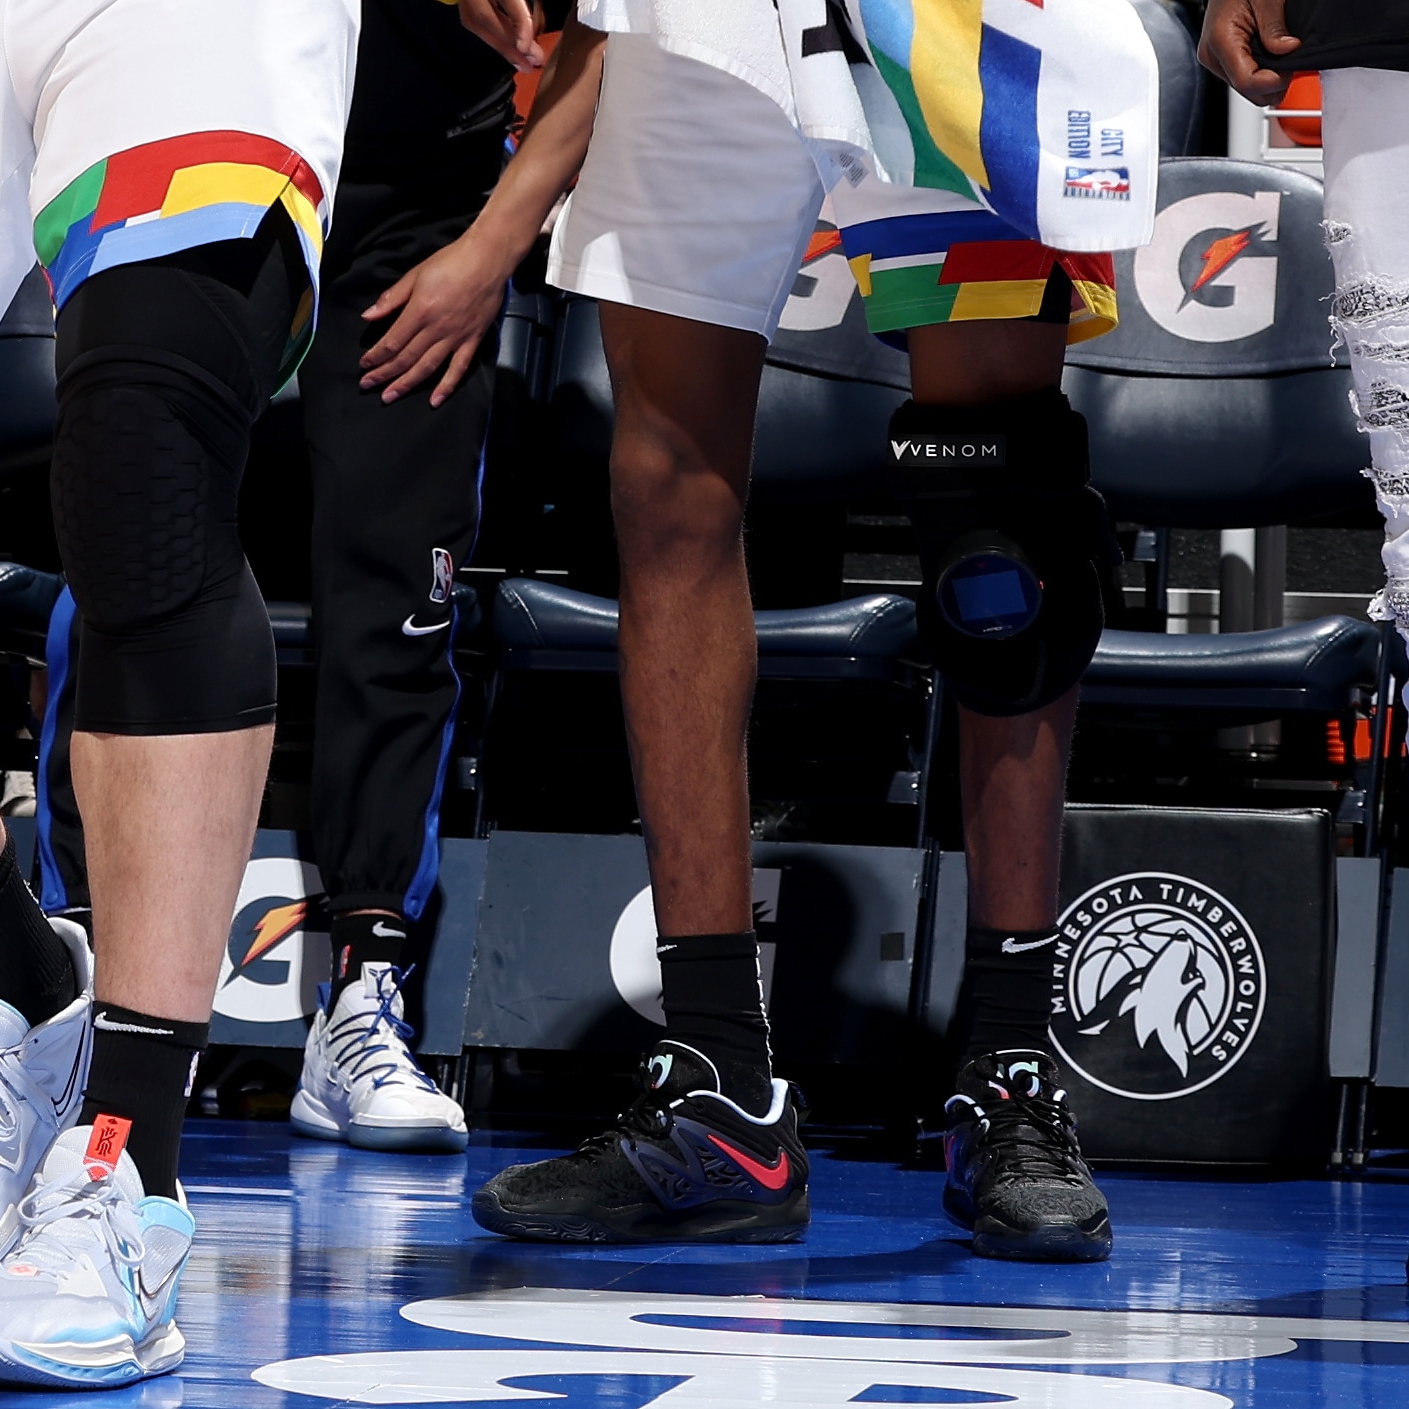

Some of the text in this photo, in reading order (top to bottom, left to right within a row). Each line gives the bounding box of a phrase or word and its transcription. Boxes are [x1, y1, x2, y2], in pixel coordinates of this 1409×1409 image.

[1067, 110, 1091, 158] EDITION
[1101, 128, 1124, 156] CITY
[1133, 191, 1280, 343] G
[1050, 883, 1257, 1062] MINNESOTA TIMBERWOLVES
